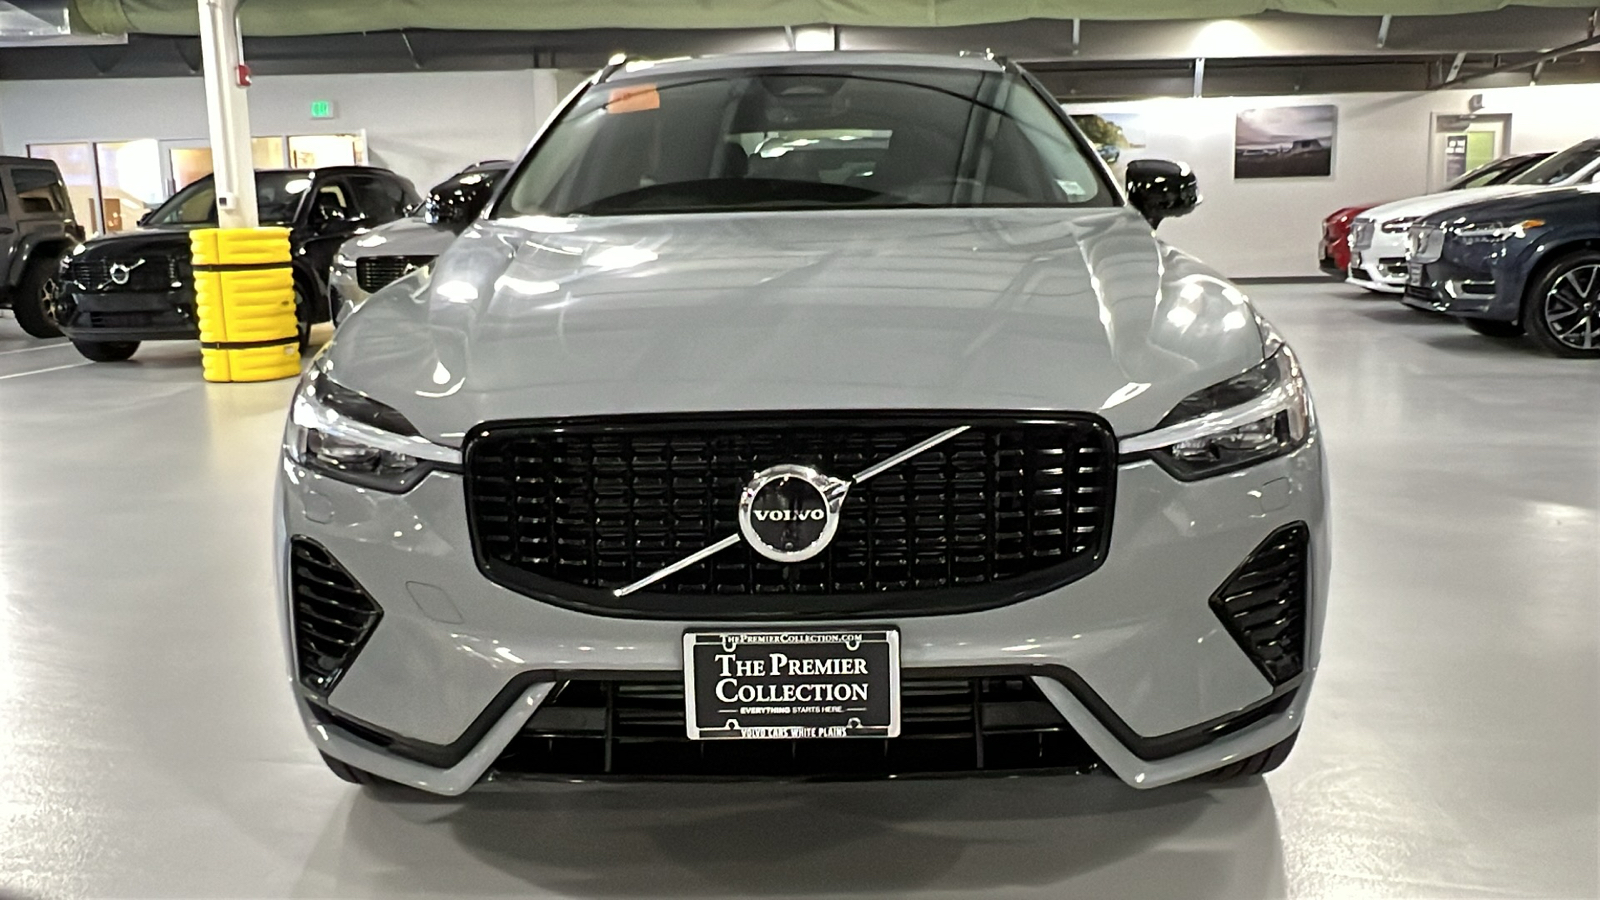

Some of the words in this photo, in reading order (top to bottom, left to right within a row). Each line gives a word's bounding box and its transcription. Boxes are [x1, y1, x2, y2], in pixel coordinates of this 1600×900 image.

[753, 508, 825, 521] VOLVO
[715, 654, 766, 677] THE
[769, 653, 868, 676] PREMIER
[715, 678, 869, 703] COLLECTION
[740, 706, 791, 714] EVERYTHING
[792, 706, 820, 714] STARTS
[791, 727, 816, 738] WHITE
[818, 727, 847, 737] PLAINS
